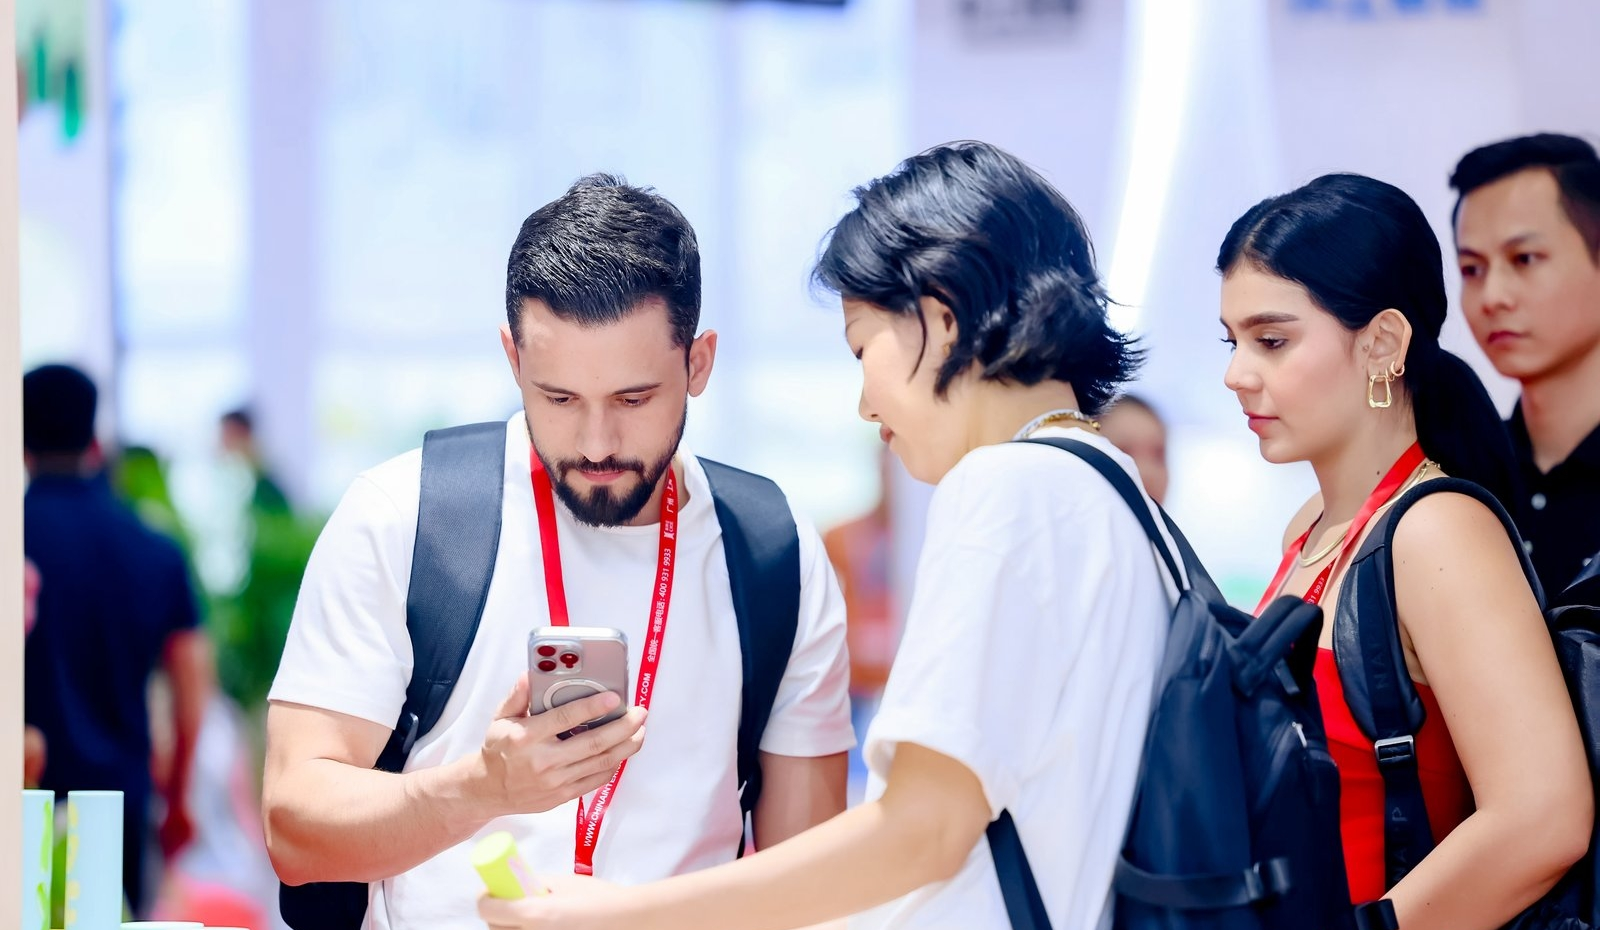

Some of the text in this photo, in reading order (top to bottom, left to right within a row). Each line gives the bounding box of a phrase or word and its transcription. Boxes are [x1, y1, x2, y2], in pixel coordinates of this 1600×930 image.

[663, 548, 672, 566] 9933
[661, 567, 670, 582] 931
[659, 582, 668, 598] 400
